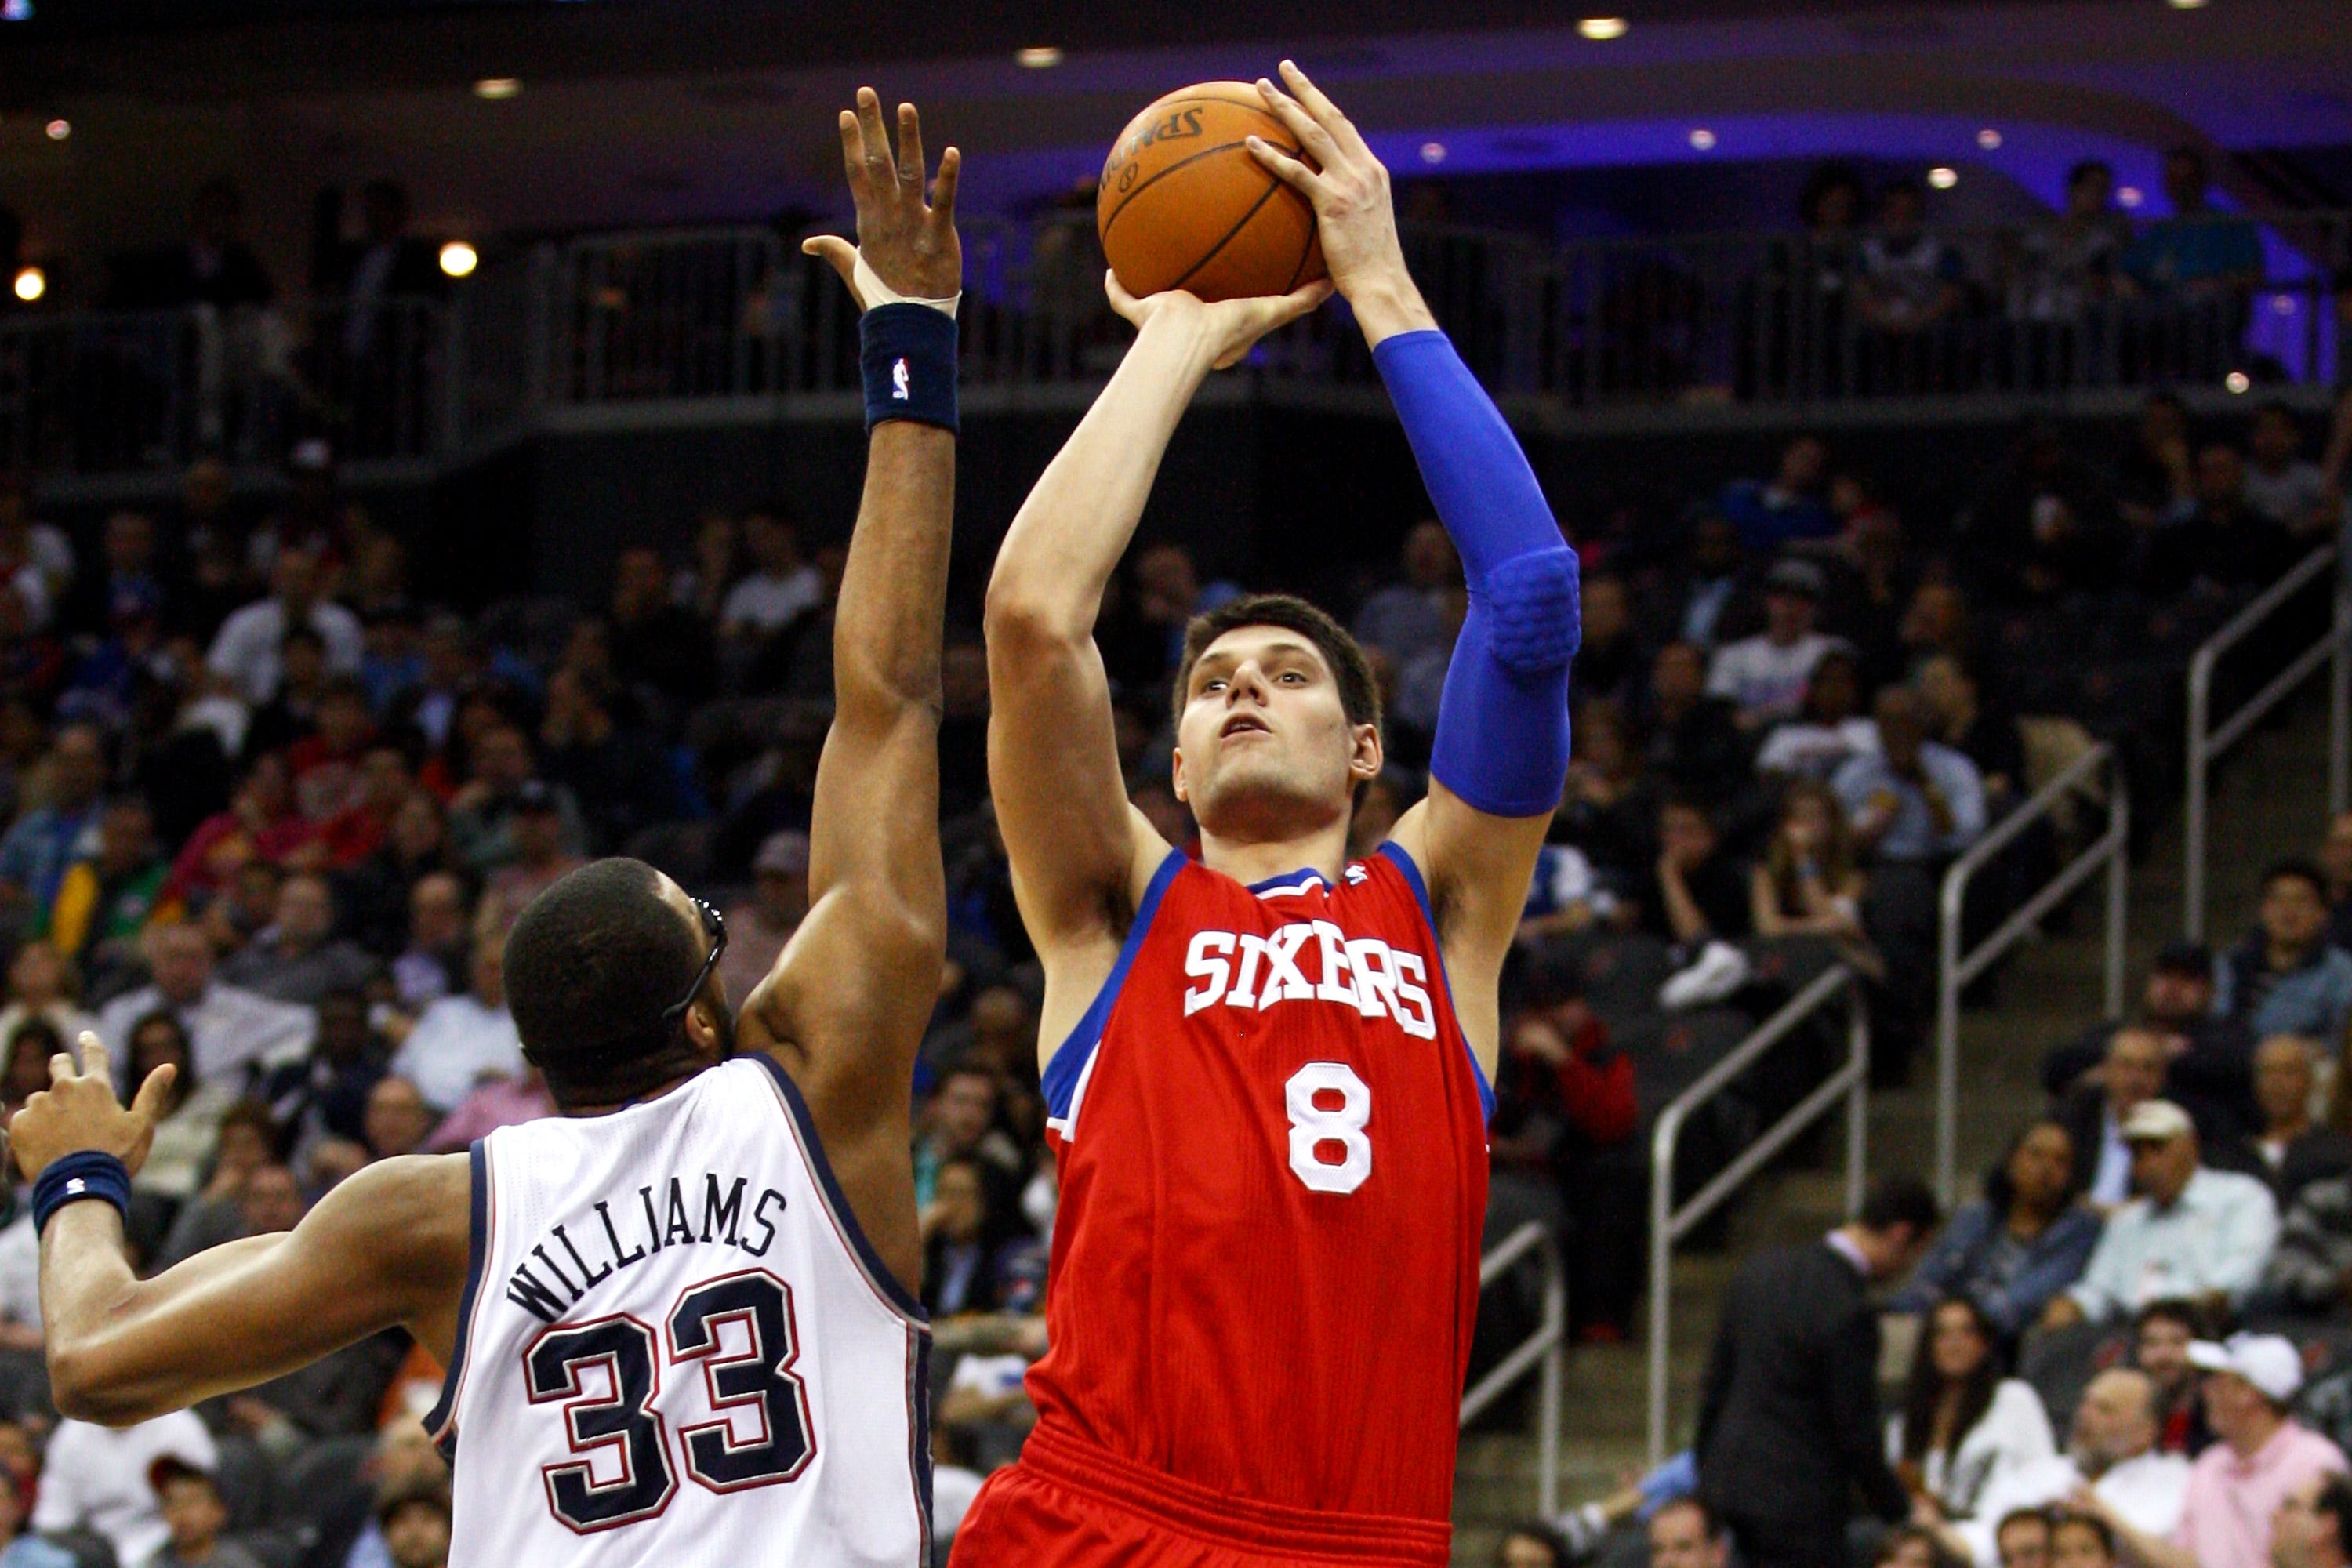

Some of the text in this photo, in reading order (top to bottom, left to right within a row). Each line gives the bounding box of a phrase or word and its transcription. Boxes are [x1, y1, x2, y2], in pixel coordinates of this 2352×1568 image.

[1184, 918, 1437, 1040] SIXERS
[1285, 1062, 1372, 1195] 8
[506, 1173, 787, 1323] WILLIAMS
[521, 1267, 817, 1536] 33
